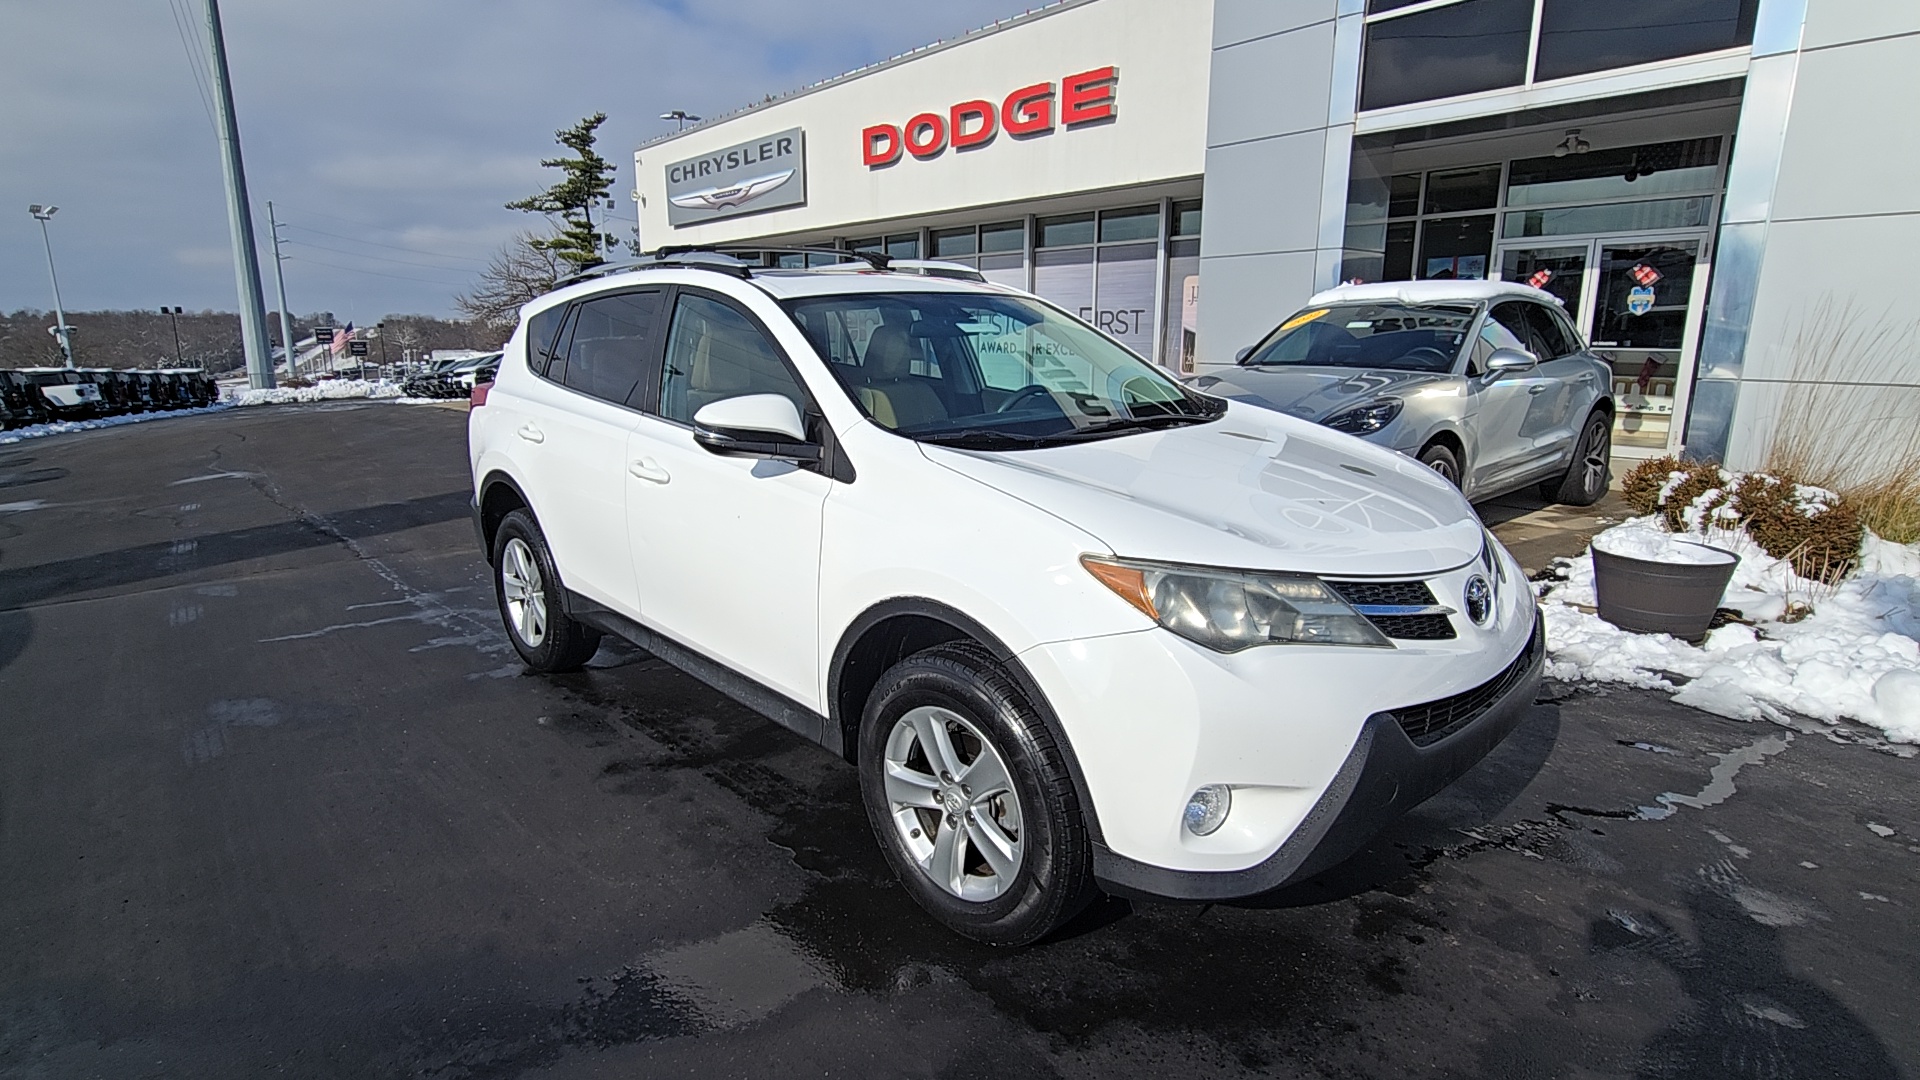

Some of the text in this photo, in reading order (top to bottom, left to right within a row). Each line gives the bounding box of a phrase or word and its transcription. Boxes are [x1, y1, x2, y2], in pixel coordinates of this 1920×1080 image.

[862, 66, 1117, 167] DODGE
[669, 136, 793, 185] CHRYSLER
[979, 340, 1018, 354] AWARD
